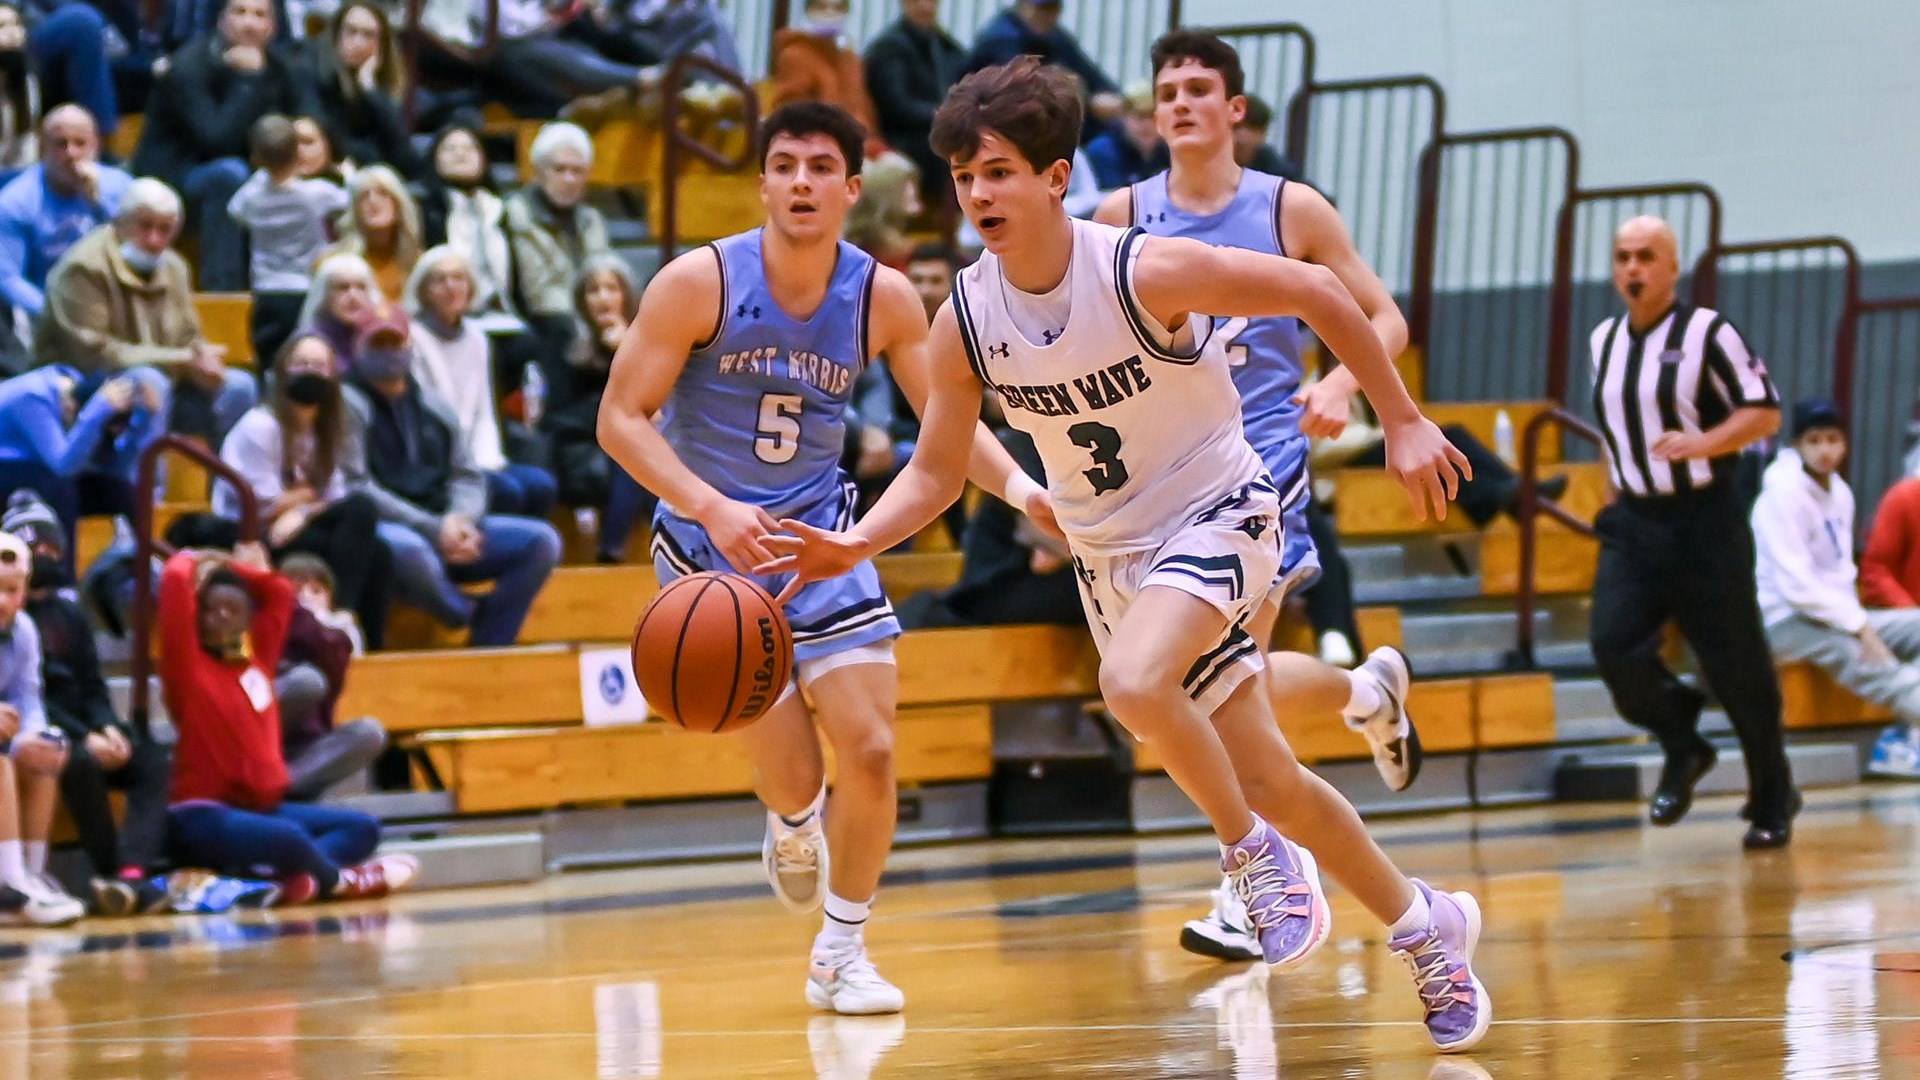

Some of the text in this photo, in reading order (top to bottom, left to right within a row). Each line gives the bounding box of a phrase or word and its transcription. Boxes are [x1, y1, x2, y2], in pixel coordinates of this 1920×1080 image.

[718, 347, 778, 375] WEST
[1072, 354, 1152, 411] WAVE
[754, 391, 804, 465] 5
[1066, 421, 1129, 497] 3
[736, 617, 776, 720] Wilson
